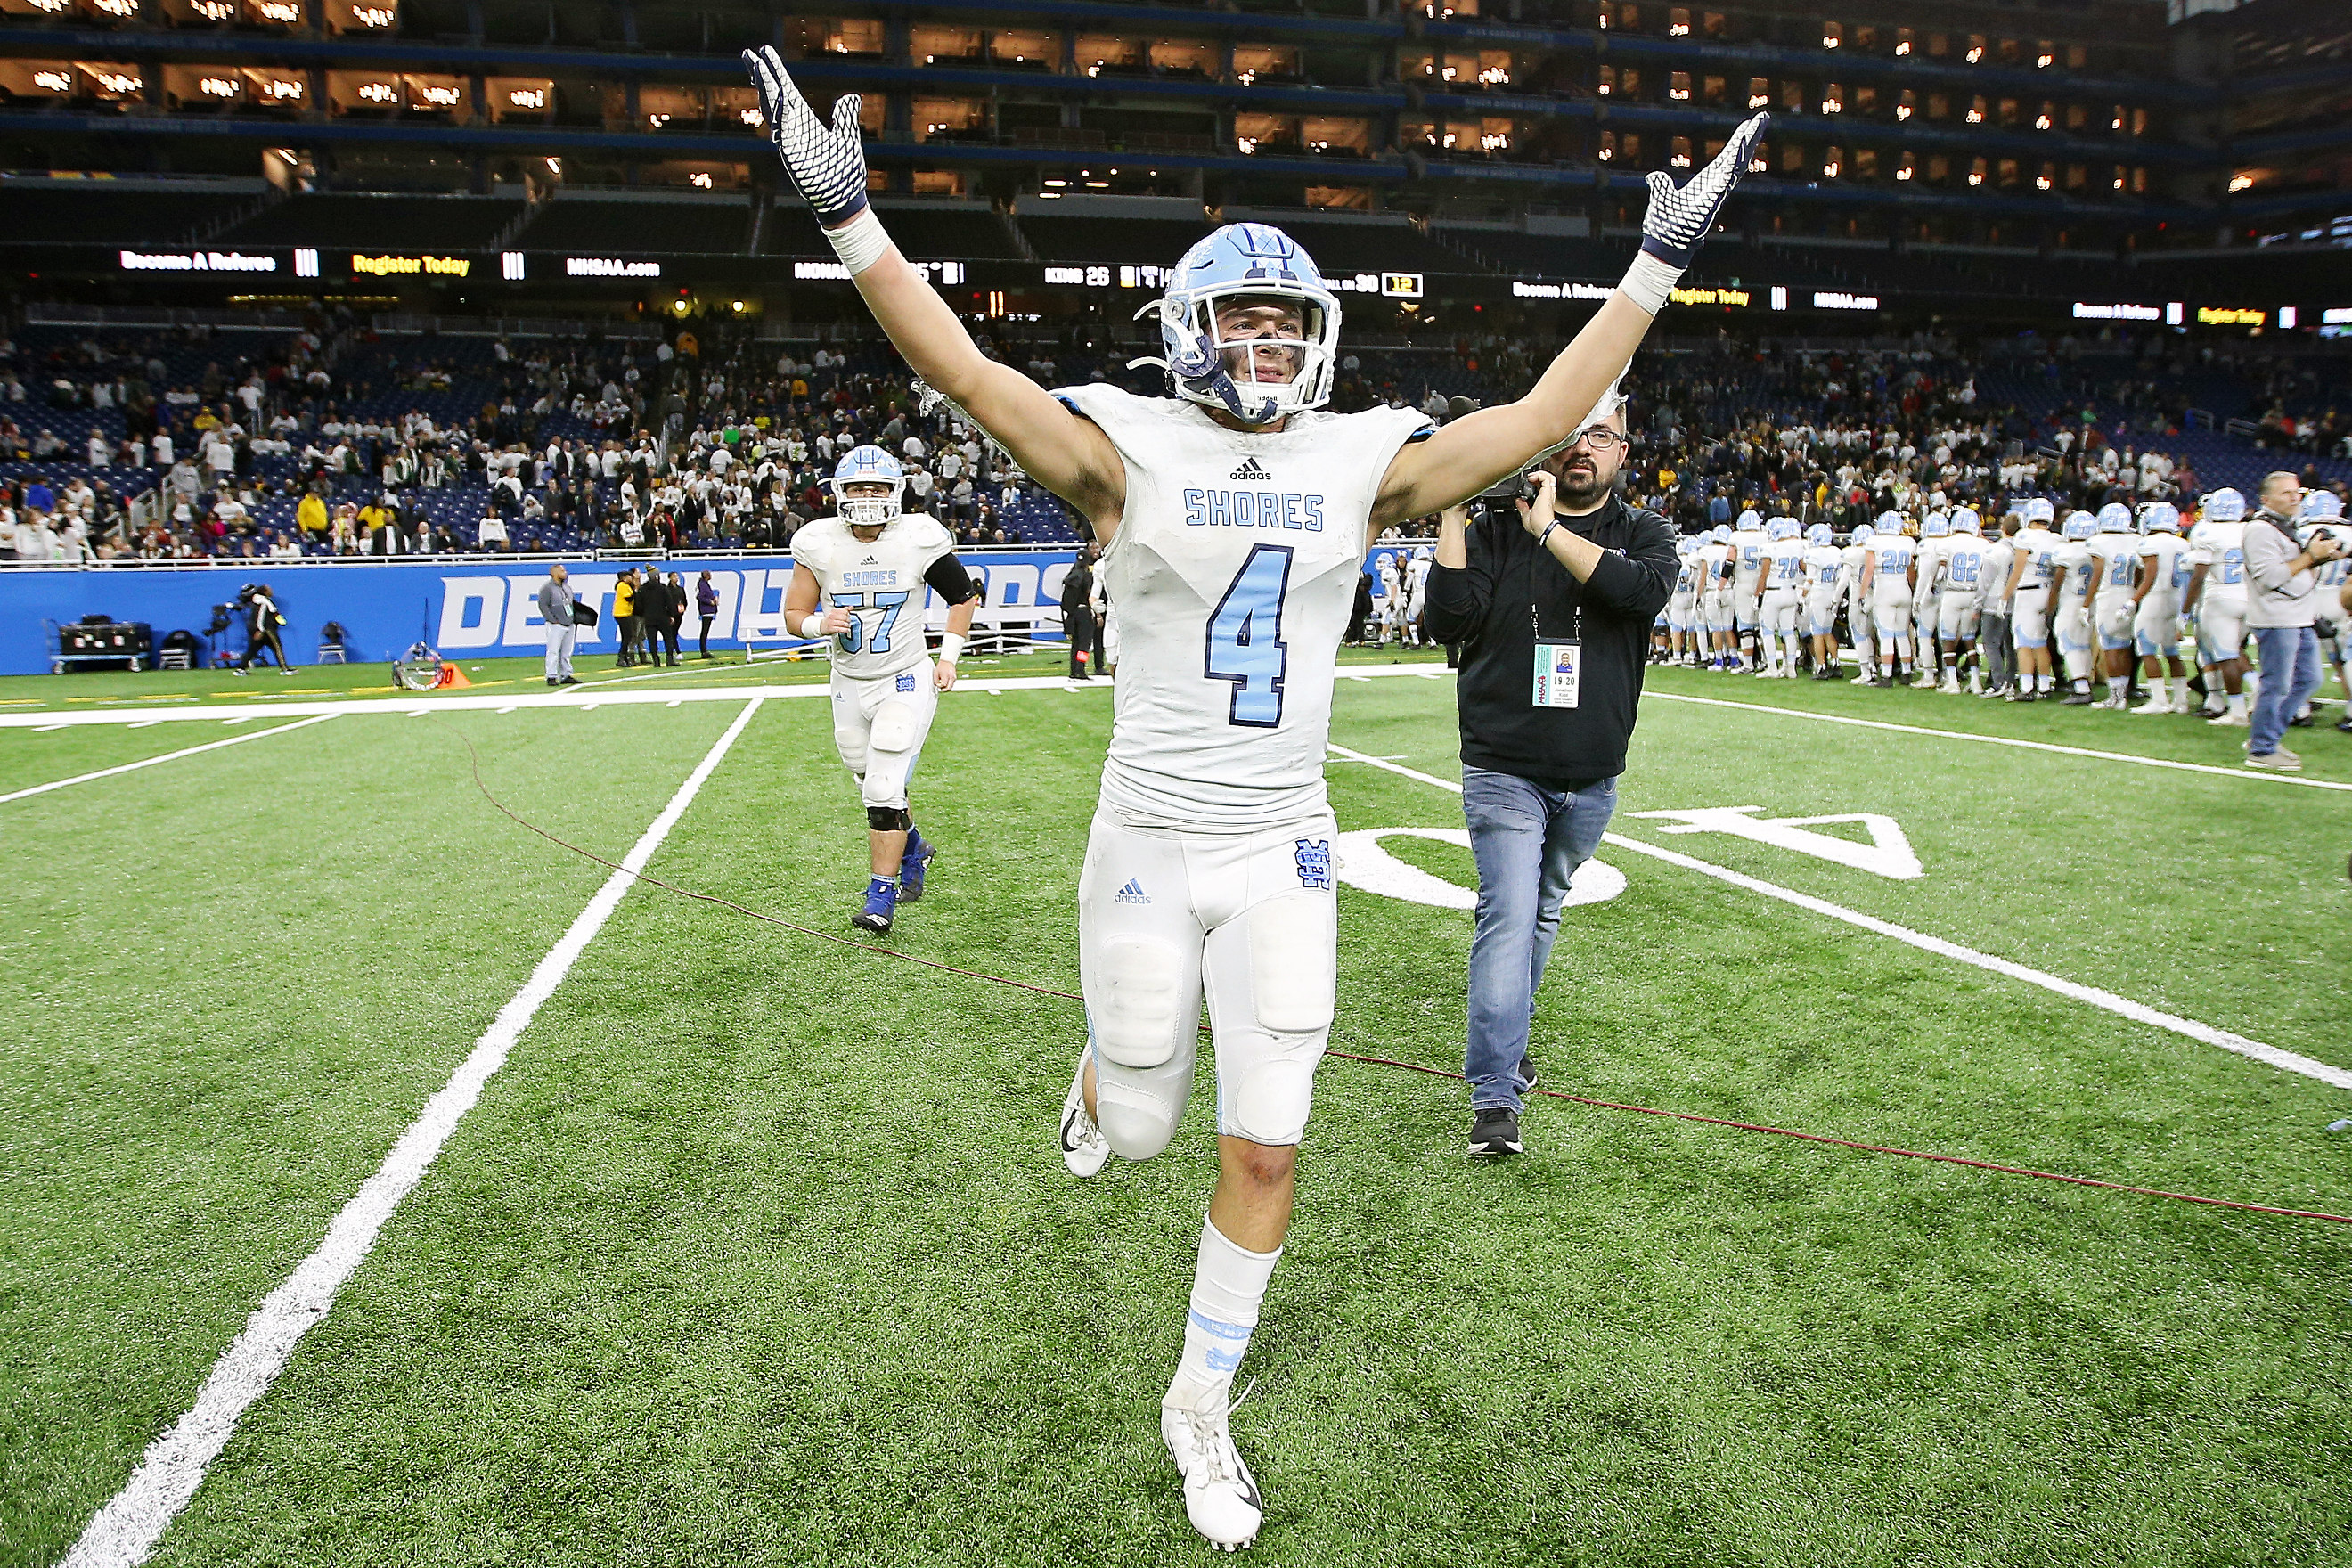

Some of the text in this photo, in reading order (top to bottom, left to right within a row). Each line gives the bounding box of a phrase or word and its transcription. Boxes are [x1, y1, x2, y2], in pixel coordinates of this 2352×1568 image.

[192, 251, 209, 270] A
[353, 254, 470, 277] Register Today
[566, 257, 661, 277] MHSAA.com
[1044, 266, 1110, 287] KING 26
[1321, 278, 1342, 291] ALL
[1391, 276, 1413, 293] 12
[1561, 282, 1572, 298] A
[1670, 287, 1750, 308] Register Today
[1230, 470, 1271, 480] adidas
[1184, 488, 1323, 533] SHORES
[1952, 551, 1981, 583] 82
[843, 570, 897, 588] SHORES
[830, 591, 910, 655] 57
[1204, 543, 1294, 729] 4
[1554, 676, 1575, 685] 19-20
[1114, 894, 1152, 905] adidas
